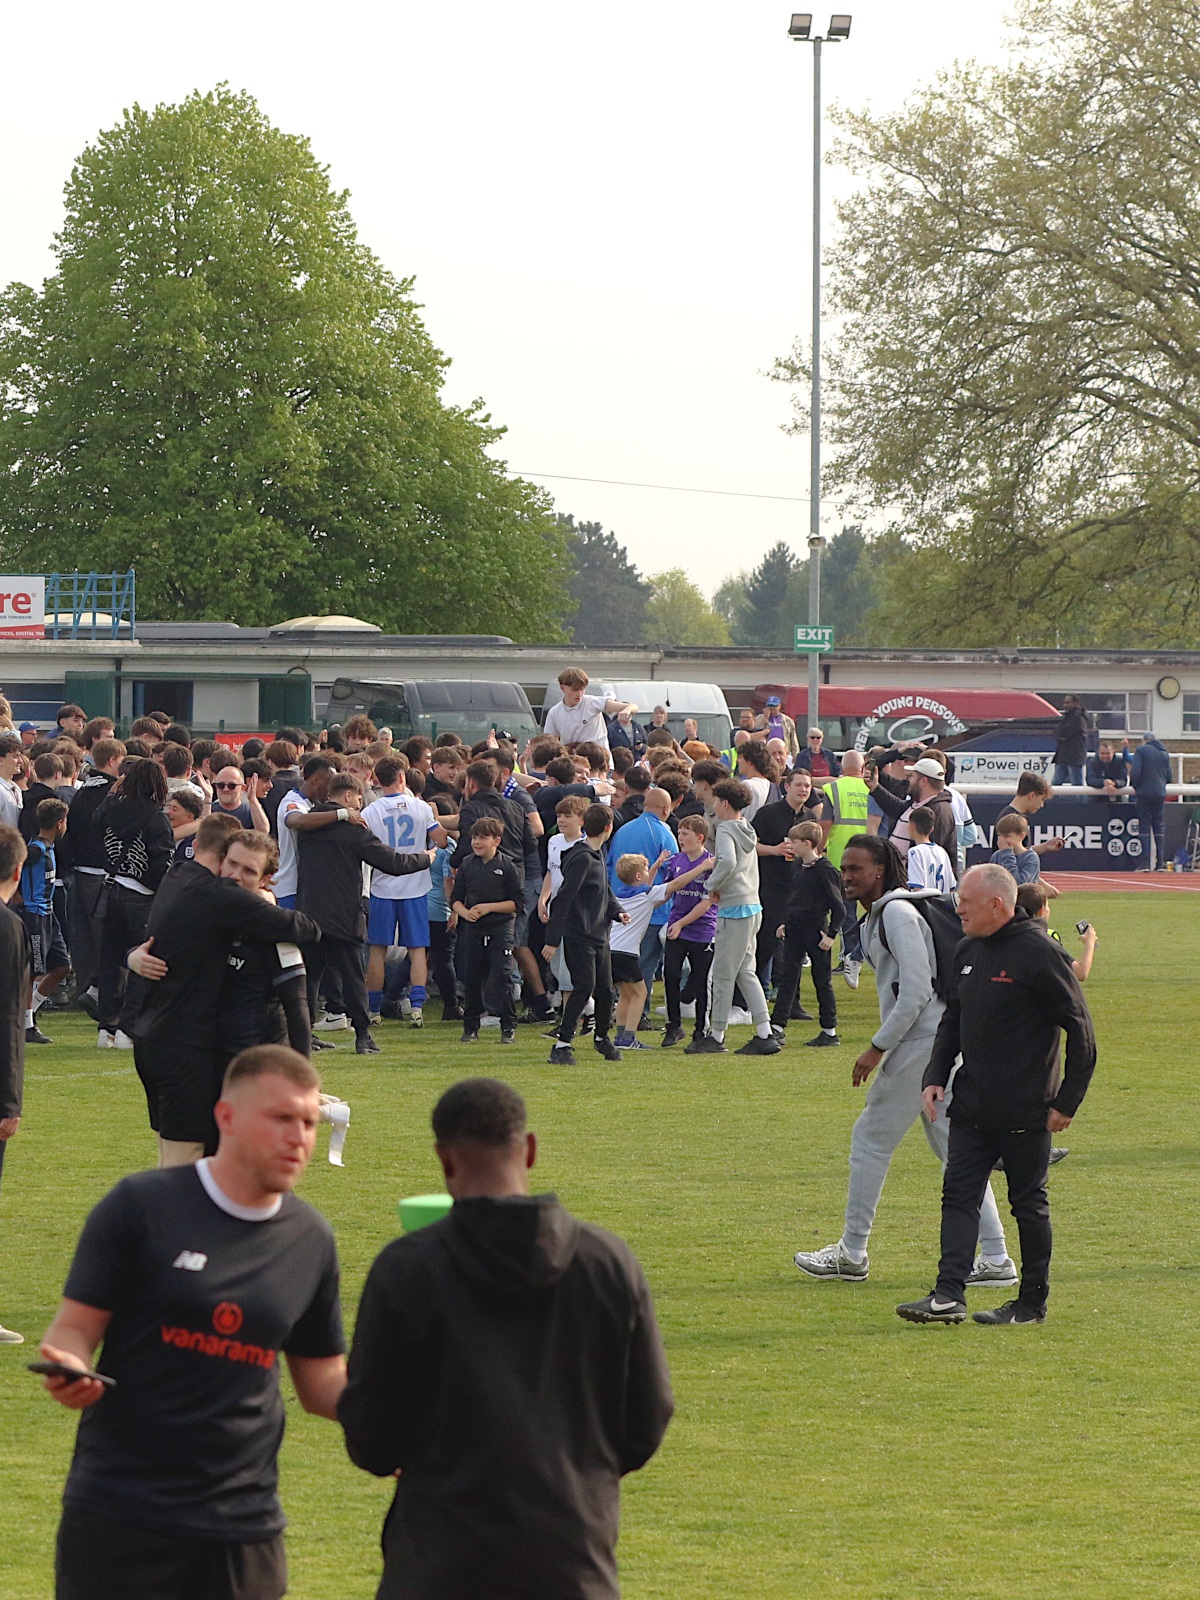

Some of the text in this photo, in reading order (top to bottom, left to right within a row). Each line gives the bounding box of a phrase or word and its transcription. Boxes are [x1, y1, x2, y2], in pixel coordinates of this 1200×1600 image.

[797, 628, 832, 640] EXIT
[872, 696, 914, 718] YOUNG
[382, 814, 416, 848] 12
[1034, 826, 1103, 849] HIRE
[161, 1325, 276, 1370] vanarama
